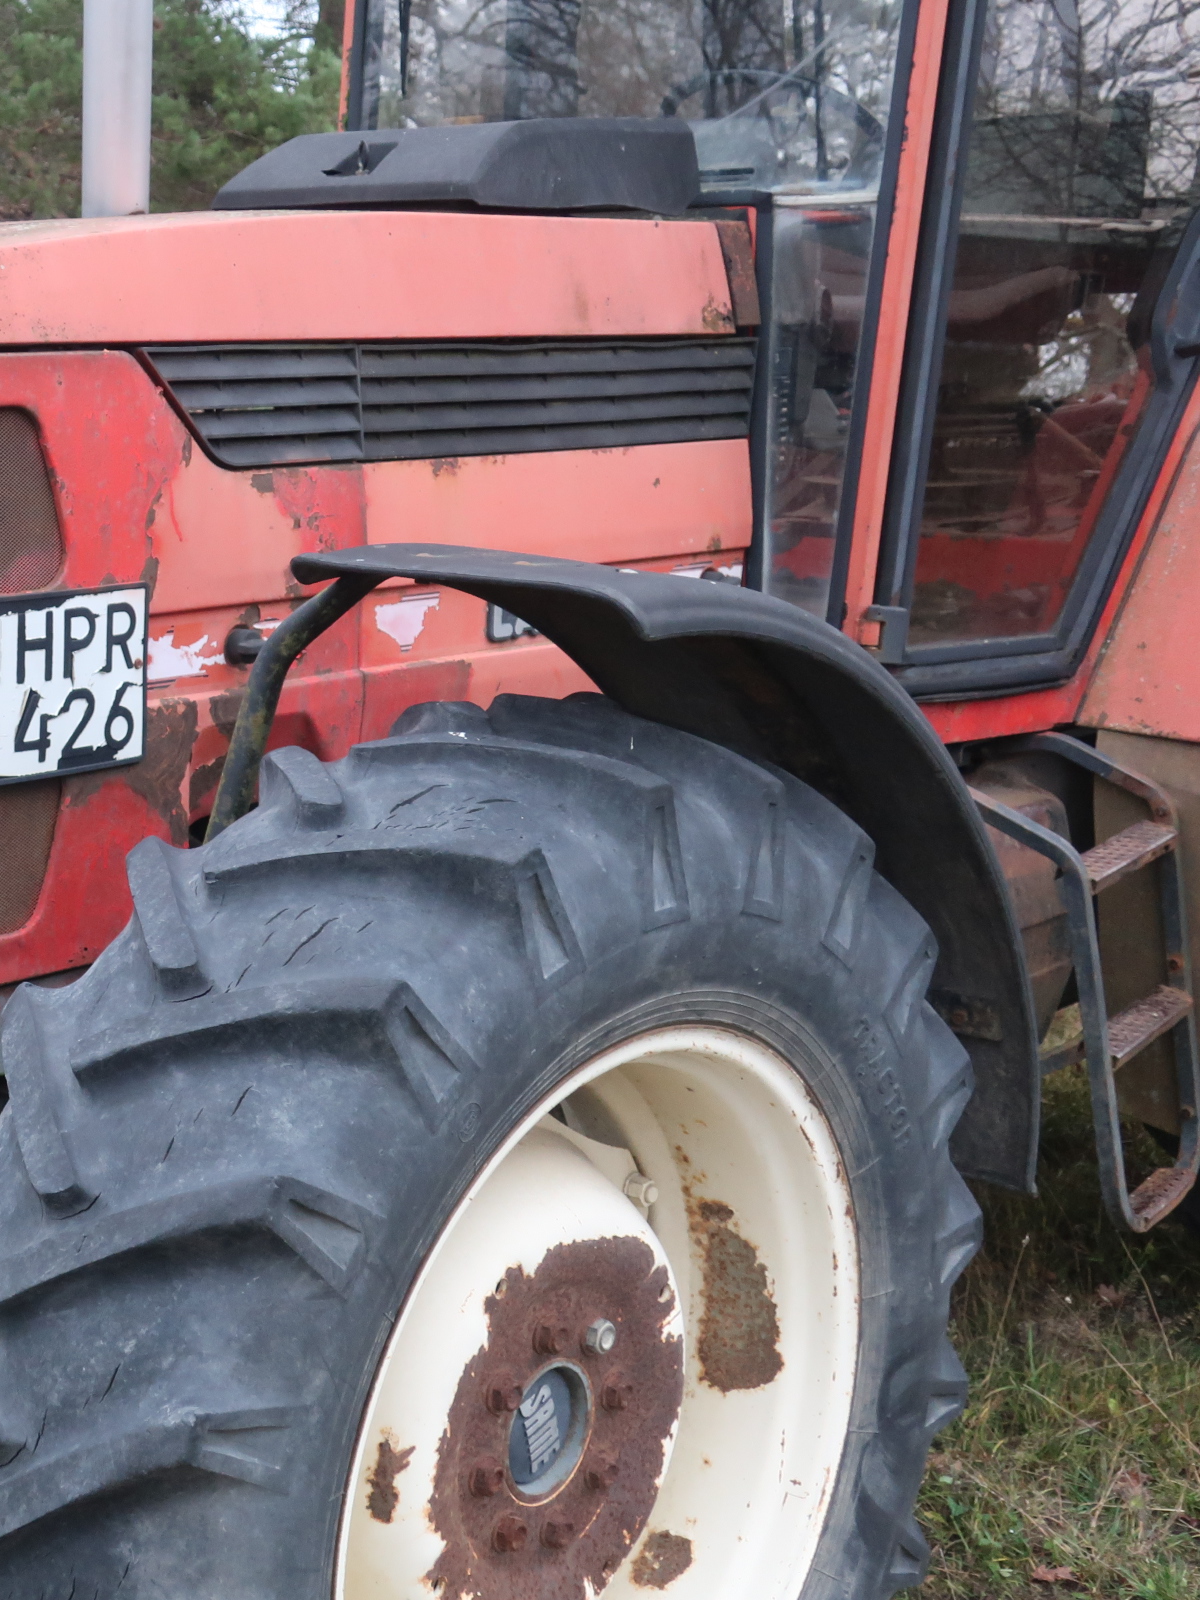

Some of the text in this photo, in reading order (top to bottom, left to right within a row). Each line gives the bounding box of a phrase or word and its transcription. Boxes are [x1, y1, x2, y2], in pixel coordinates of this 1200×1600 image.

[16, 602, 137, 685] HPR
[14, 682, 135, 763] 426
[519, 1384, 560, 1474] SAME
